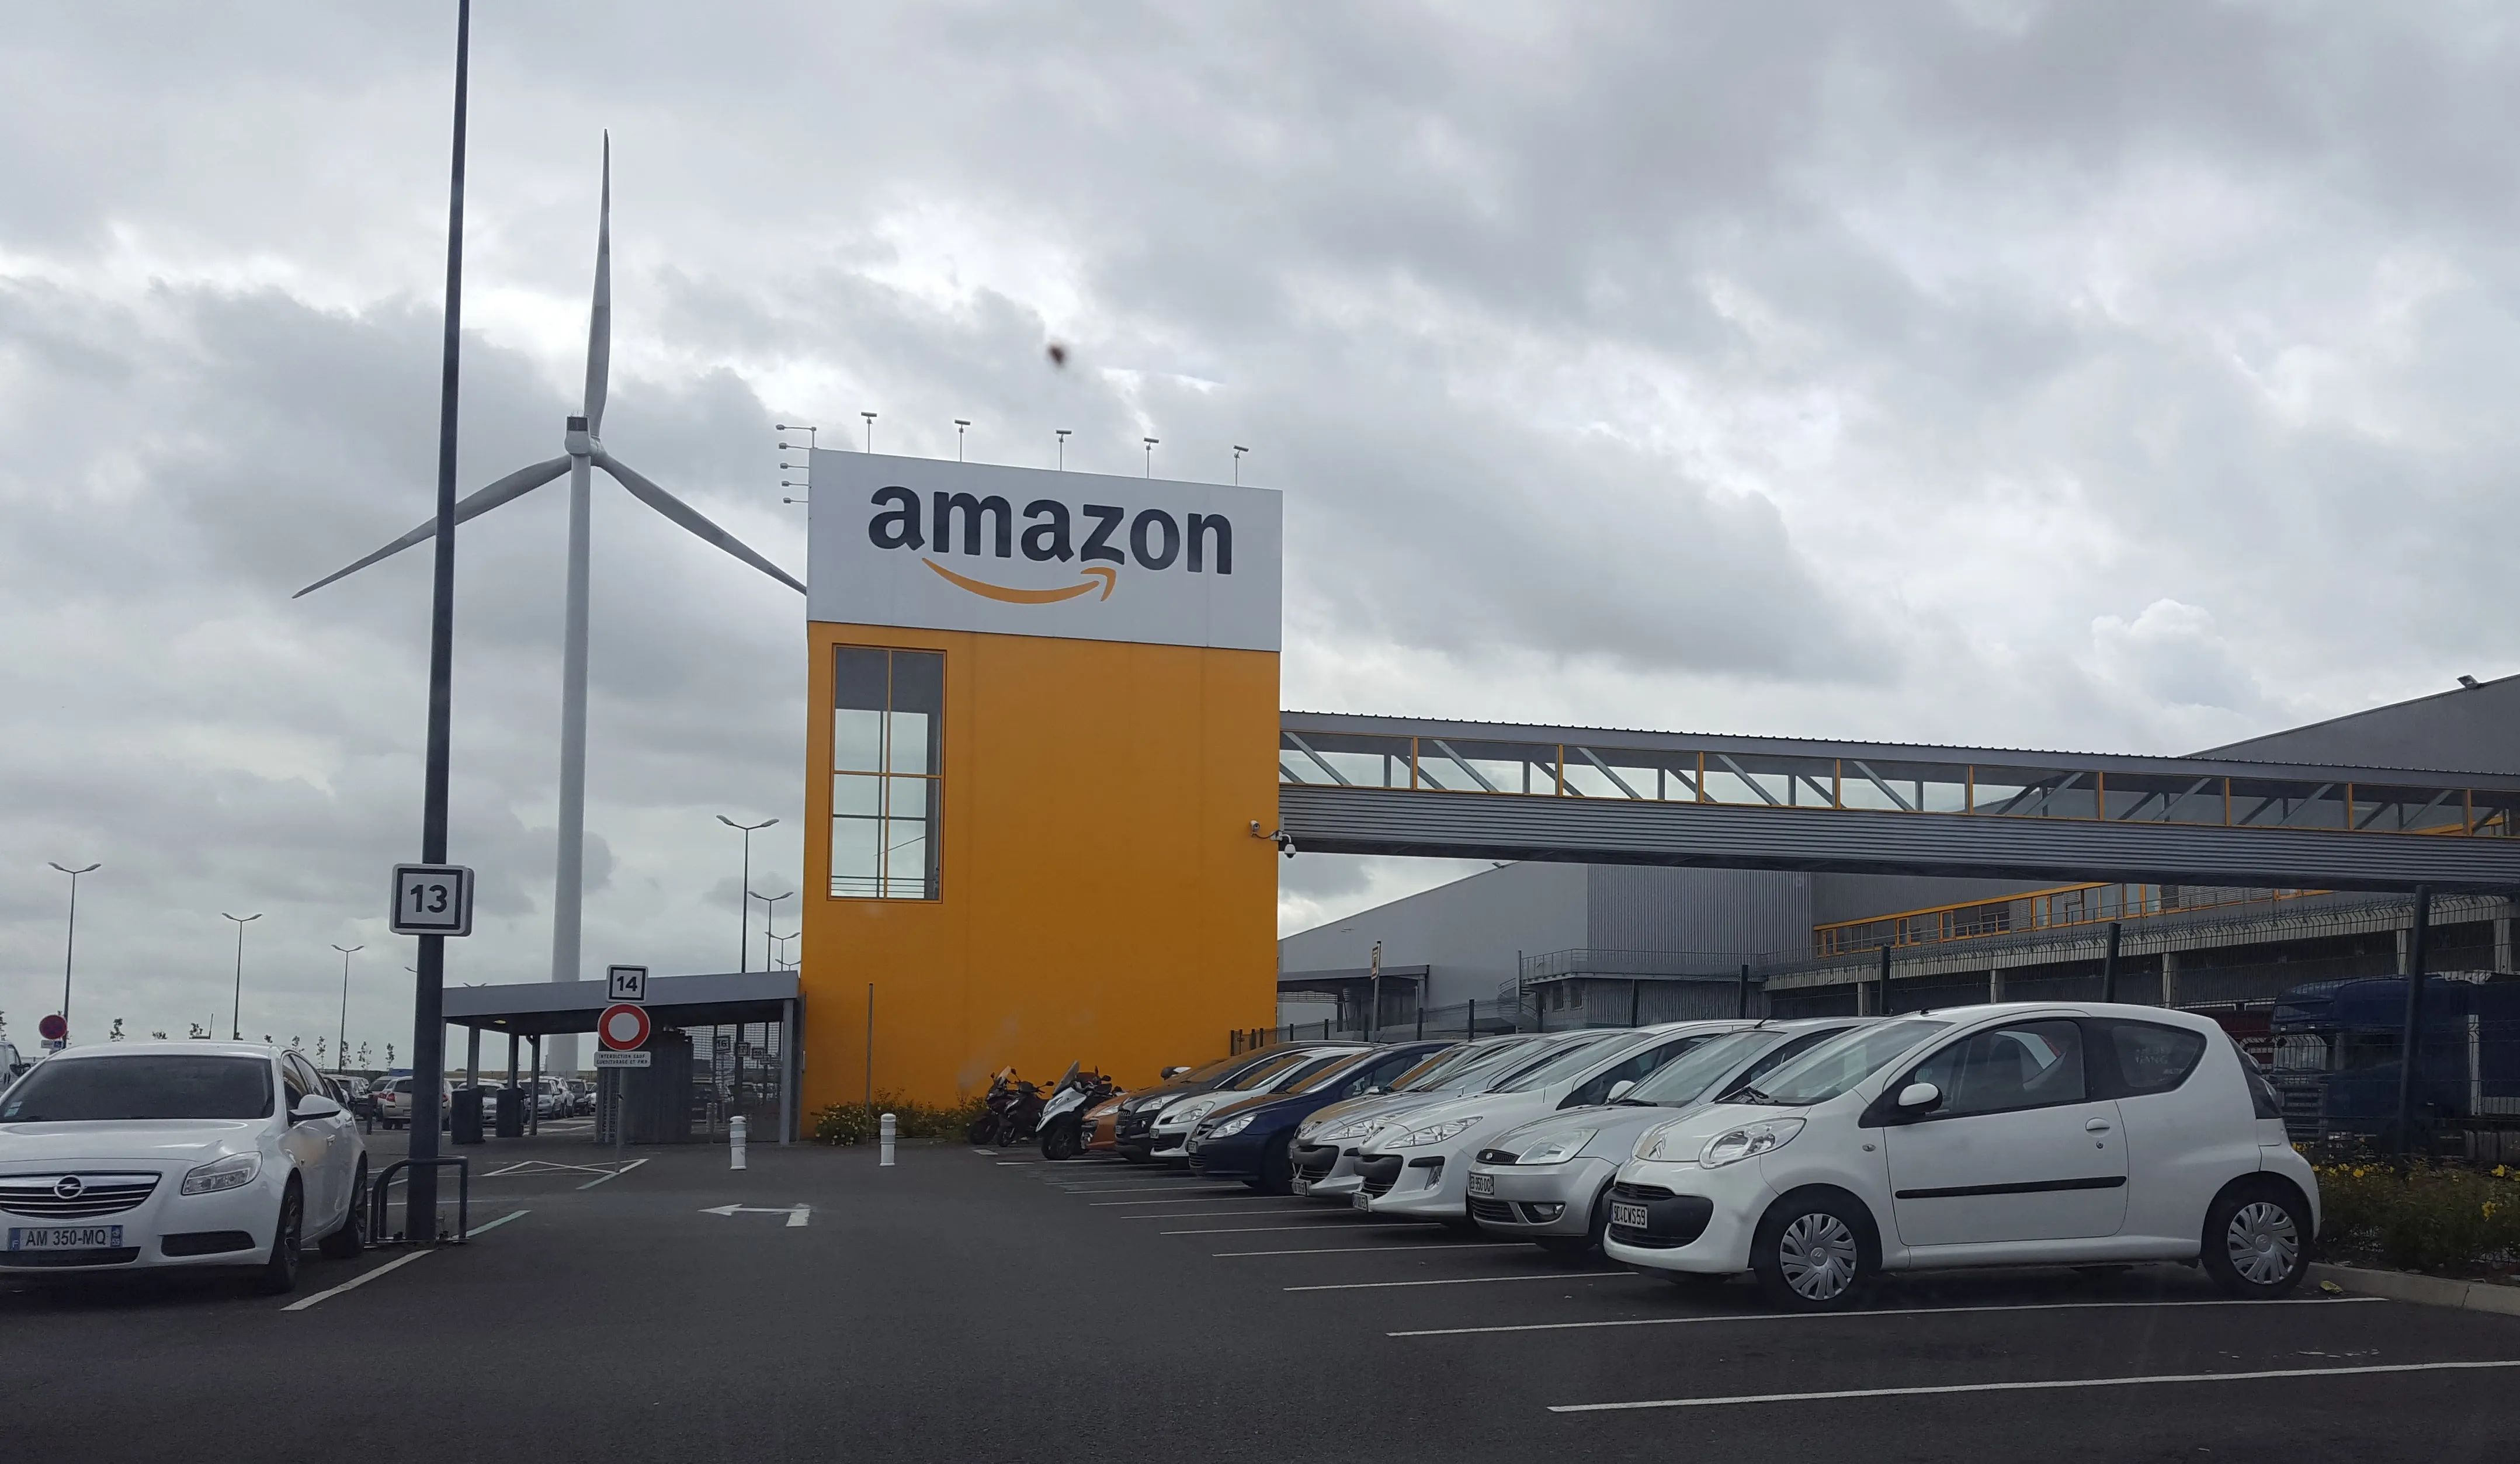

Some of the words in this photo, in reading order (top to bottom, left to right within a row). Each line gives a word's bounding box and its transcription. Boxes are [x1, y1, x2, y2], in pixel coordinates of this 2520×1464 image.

[868, 486, 1233, 575] amazon
[410, 884, 447, 913] 13
[617, 976, 638, 992] 14
[25, 1231, 48, 1246] AM
[53, 1229, 106, 1246] 350-MQ
